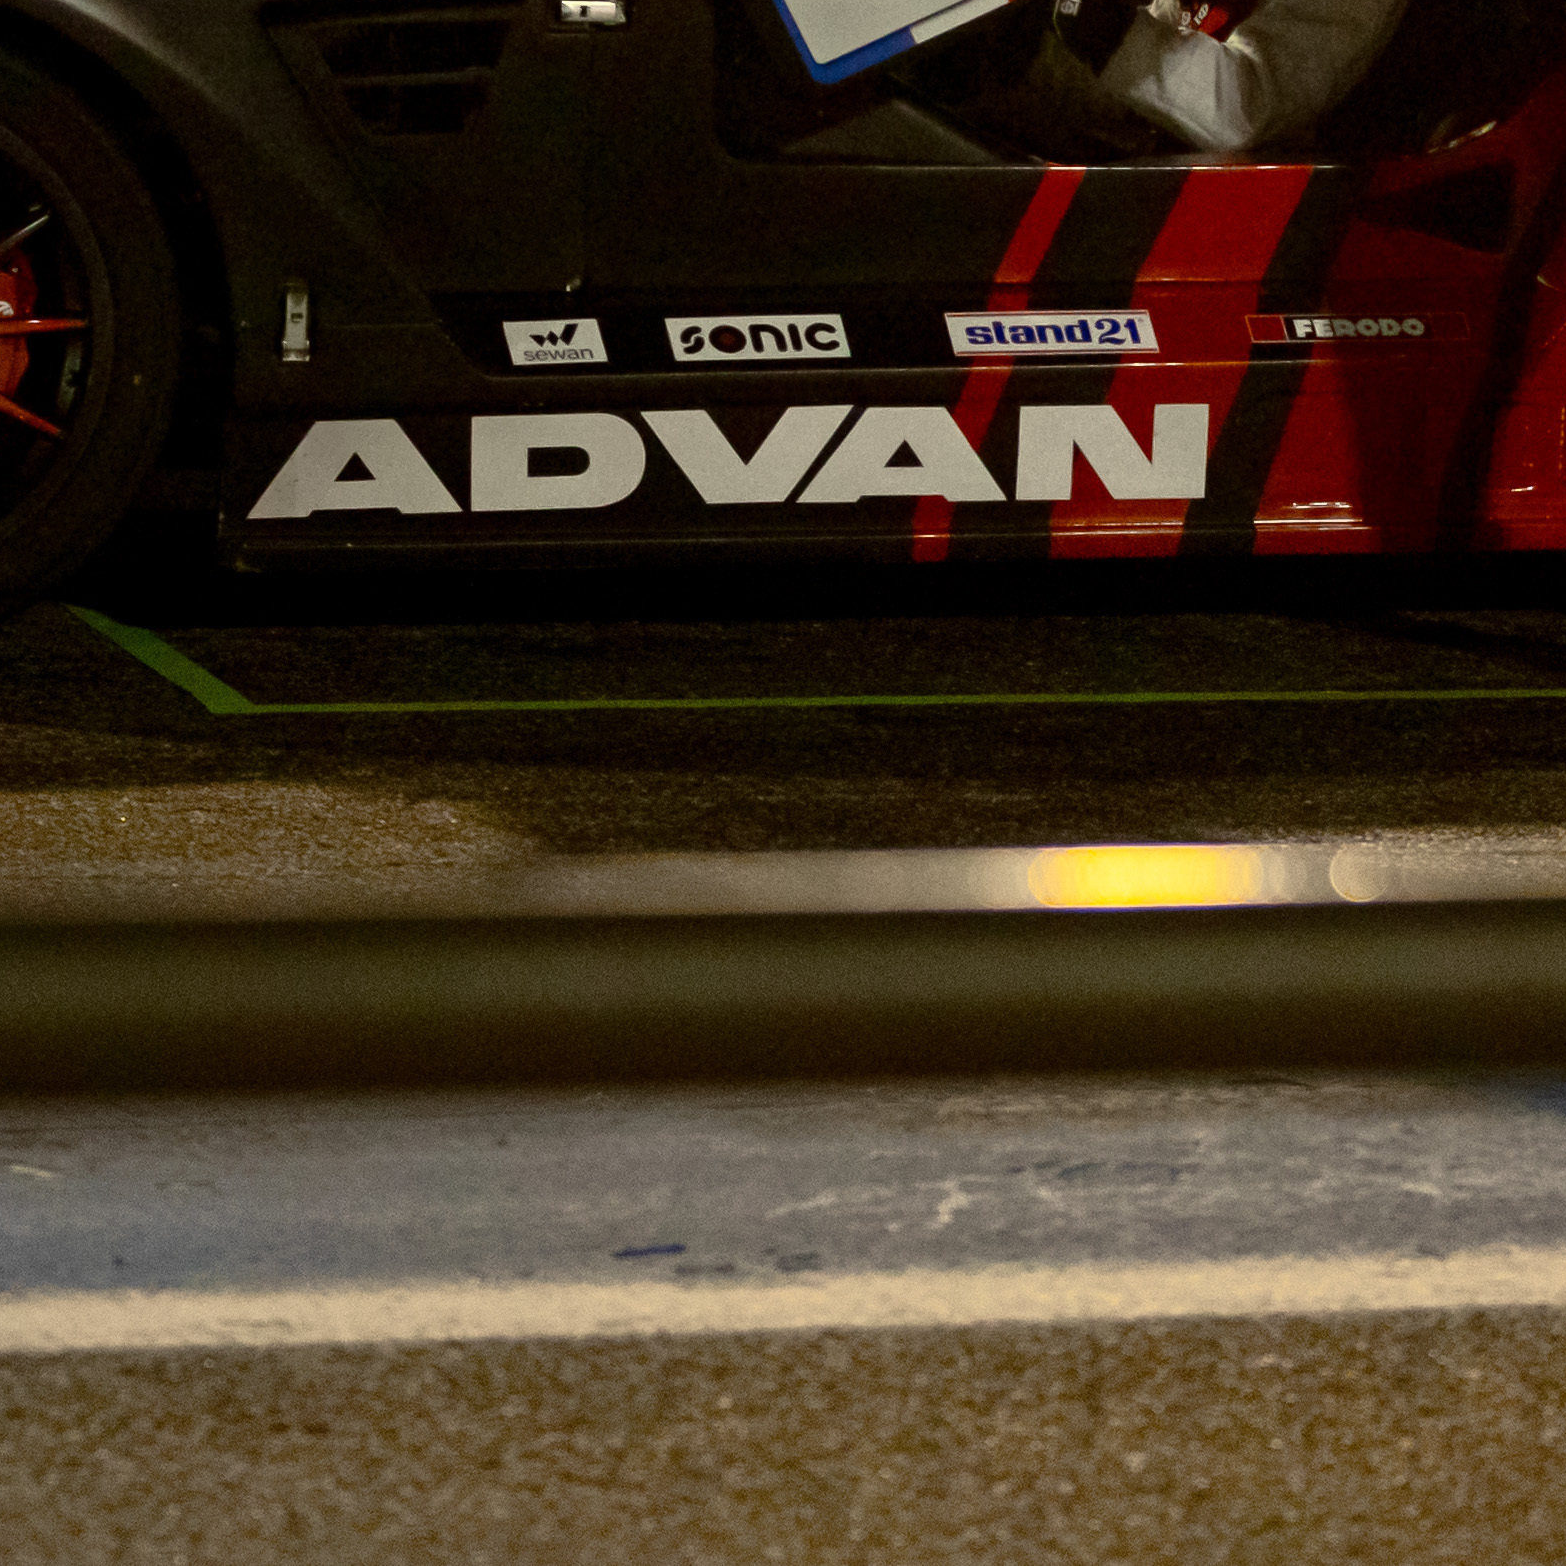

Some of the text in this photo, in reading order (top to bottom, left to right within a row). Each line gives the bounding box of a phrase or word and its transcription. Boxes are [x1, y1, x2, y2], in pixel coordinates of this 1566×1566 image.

[965, 318, 1142, 345] stand21
[1292, 318, 1425, 338] FERODO
[523, 348, 594, 362] sewan
[246, 403, 1211, 518] ADVAN
